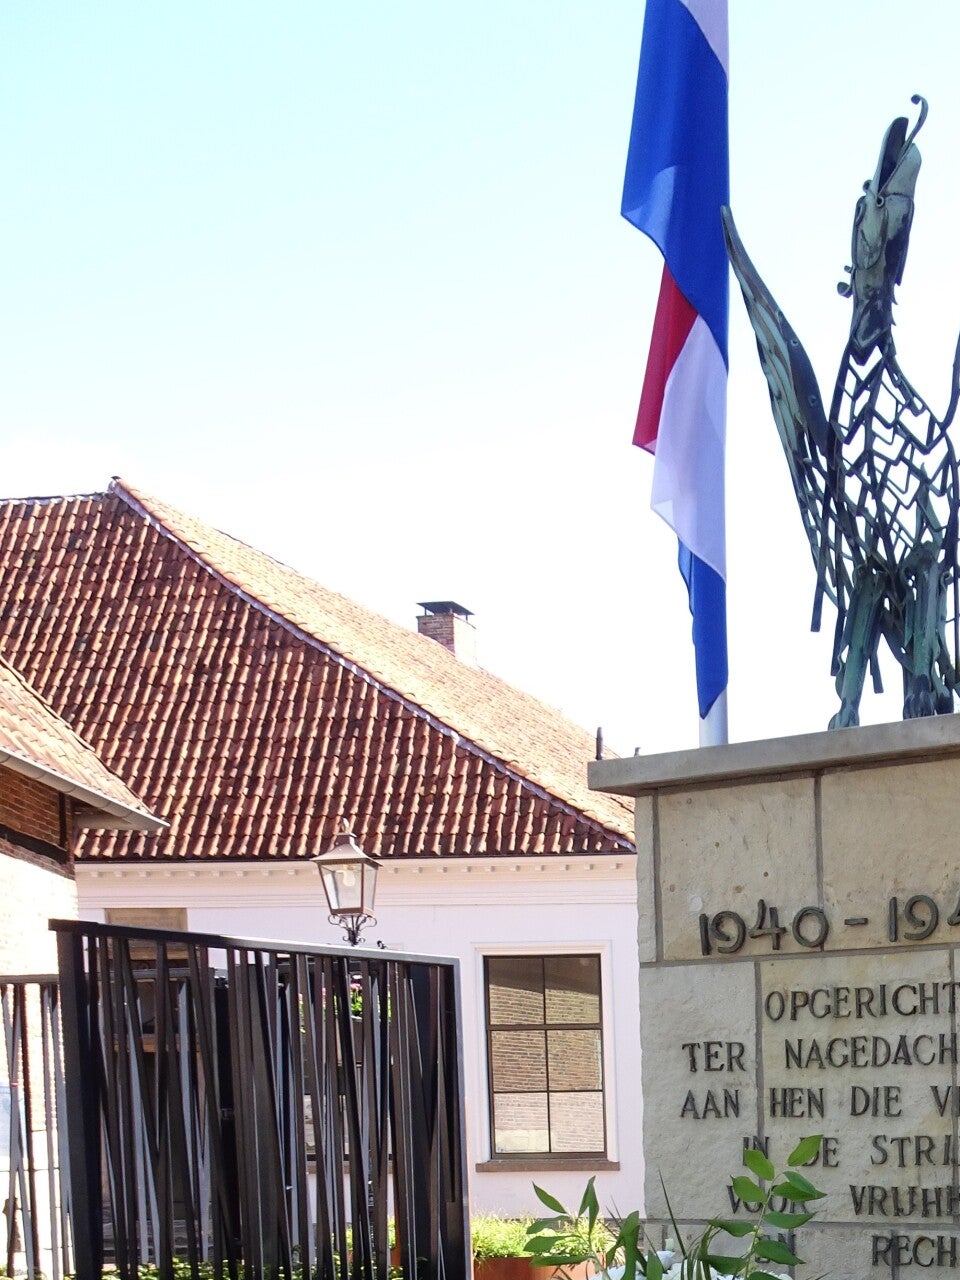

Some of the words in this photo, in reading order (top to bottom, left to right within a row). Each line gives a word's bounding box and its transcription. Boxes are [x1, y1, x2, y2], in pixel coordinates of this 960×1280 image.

[700, 898, 830, 956] 1940
[681, 1041, 746, 1073] TER
[680, 1089, 740, 1120] AAN
[769, 1087, 825, 1119] HEN
[850, 1085, 902, 1119] DIE
